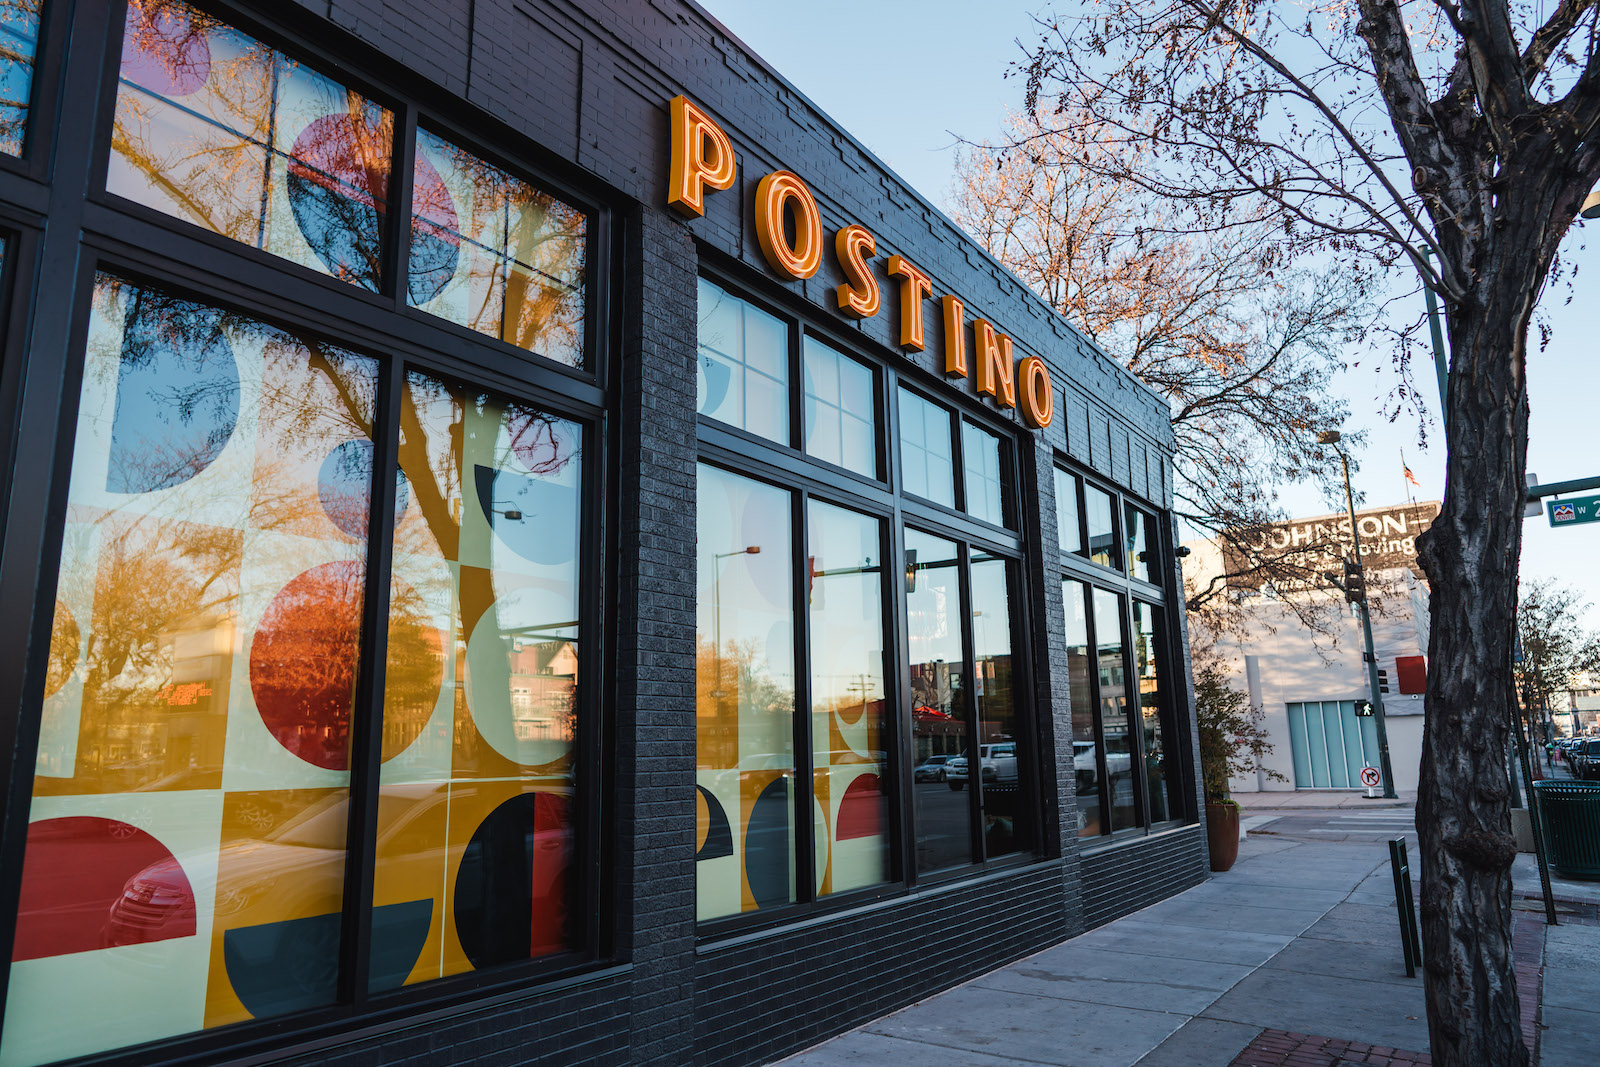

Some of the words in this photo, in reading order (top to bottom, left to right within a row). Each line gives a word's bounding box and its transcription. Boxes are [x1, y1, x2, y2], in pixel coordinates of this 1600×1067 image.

[668, 94, 1054, 429] POSTINO
[1577, 506, 1586, 514] W
[1340, 535, 1416, 559] Moving
